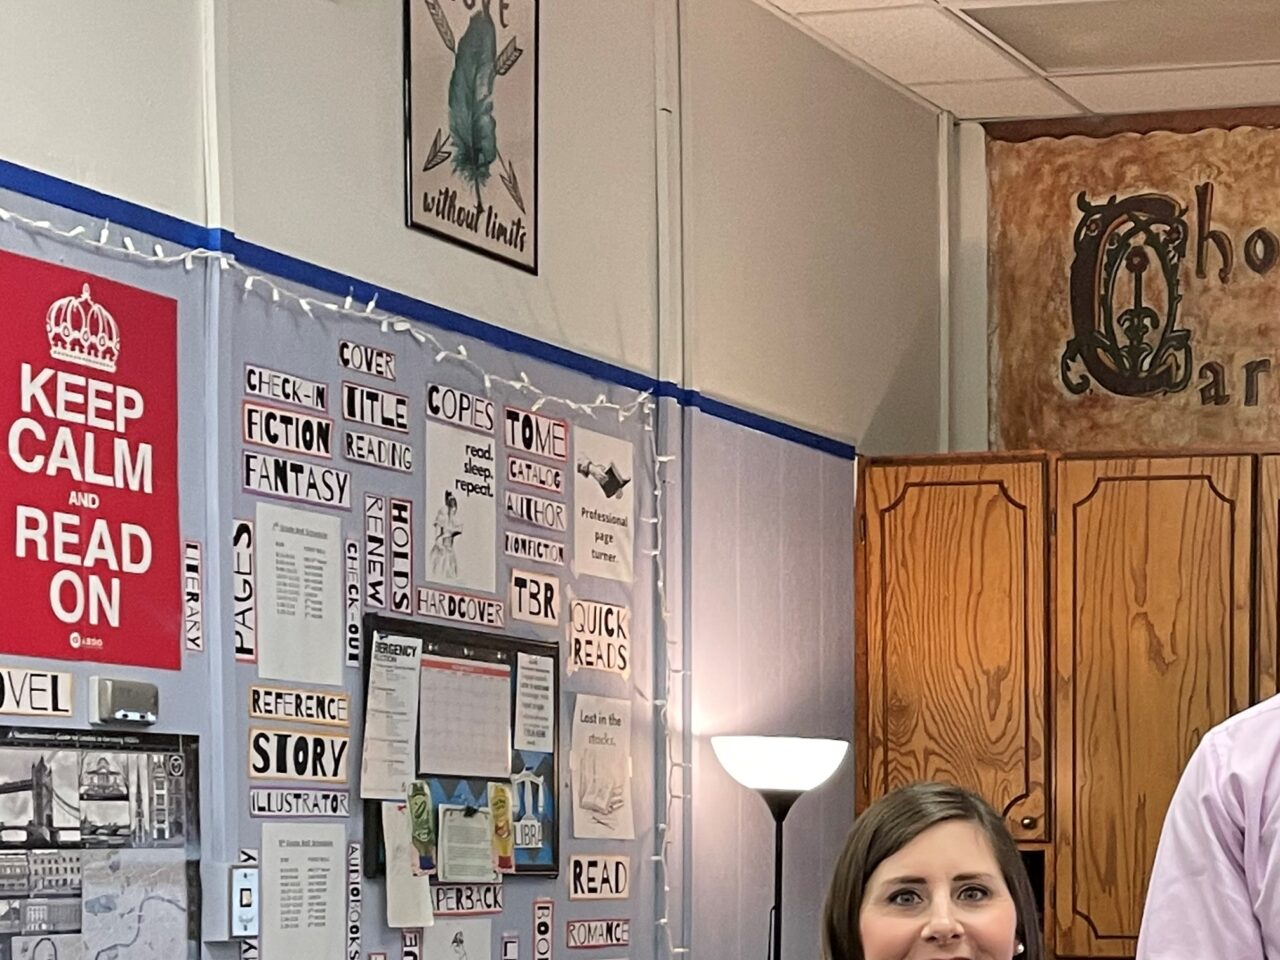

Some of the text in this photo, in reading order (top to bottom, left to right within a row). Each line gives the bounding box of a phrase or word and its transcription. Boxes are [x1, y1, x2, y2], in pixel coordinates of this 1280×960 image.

[423, 186, 527, 252] without limits
[340, 342, 395, 376] COVER
[20, 364, 144, 434] KEEP
[247, 368, 326, 408] CHECK-IN
[345, 385, 408, 429] TITLE
[428, 385, 494, 432] COPIES
[247, 408, 331, 454] FICTION
[506, 410, 566, 458] TOME
[8, 418, 153, 494] CALM
[346, 433, 412, 470] READING
[464, 459, 494, 480] sleep.
[466, 444, 494, 461] read.
[244, 455, 349, 504] FANTASY
[455, 478, 494, 498] repeat.
[510, 460, 560, 489] CATALOG
[68, 490, 100, 509] AND
[507, 495, 565, 528] AUTHOR
[581, 507, 628, 527] Professional
[15, 506, 152, 575] READ
[367, 496, 384, 605] RENEW
[392, 503, 409, 611] HOLDS
[505, 534, 564, 563] NONFICTION
[595, 532, 614, 545] page
[50, 570, 120, 628] ON
[233, 523, 254, 657] PAGES
[346, 542, 359, 661] CHECK-OUT
[418, 590, 504, 625] HARDCOVER
[514, 576, 556, 620] TBR
[573, 602, 627, 639] QUICK
[573, 641, 627, 670] READS
[0, 671, 69, 712] VEL
[252, 689, 347, 721] REFERENCE
[580, 710, 622, 727] Lost in the
[252, 732, 348, 778] STORY
[252, 793, 349, 814] ILLUSTRATOR
[573, 860, 627, 894] READ
[349, 846, 361, 960] AUDIOBOOKS
[431, 886, 502, 911] PERBACK
[569, 921, 629, 943] ROMANCE
